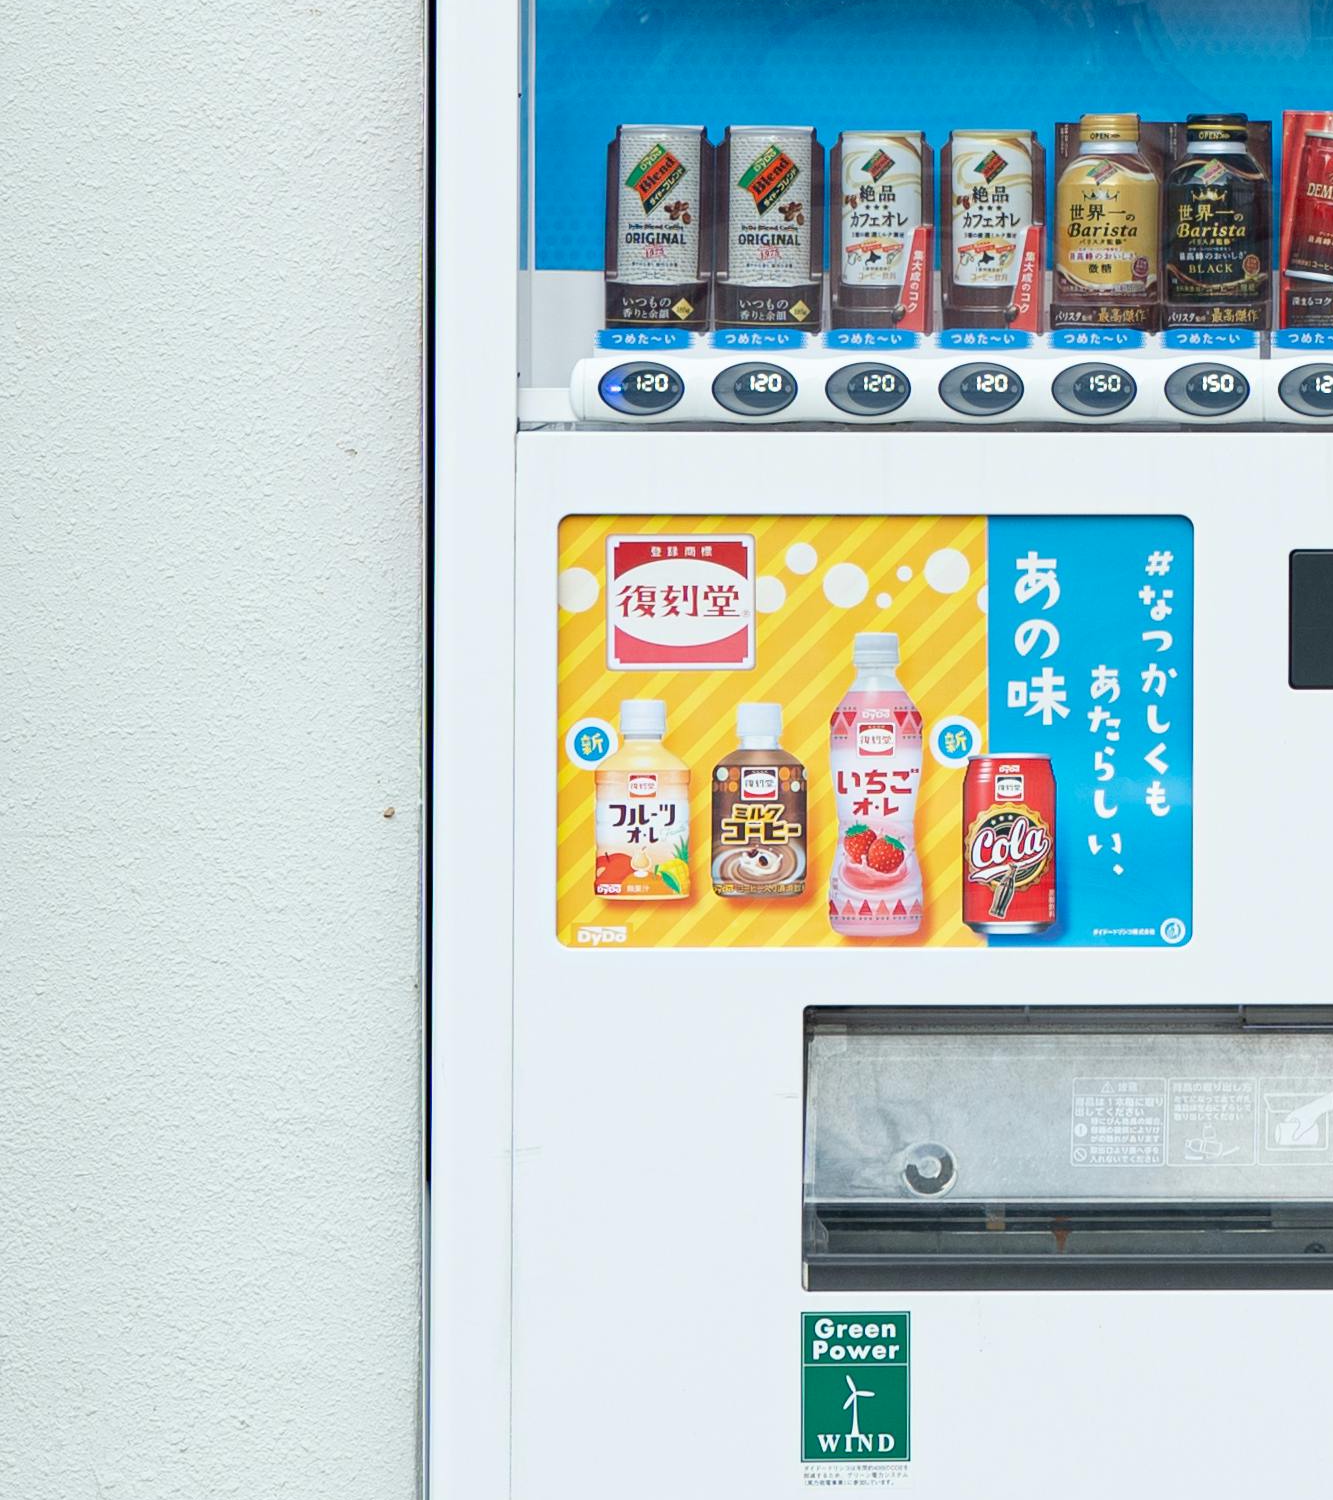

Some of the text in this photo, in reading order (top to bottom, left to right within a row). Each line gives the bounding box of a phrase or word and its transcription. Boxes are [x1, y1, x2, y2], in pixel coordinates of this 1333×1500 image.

[850, 212, 909, 227] カフェオレ
[962, 212, 1021, 228] カフェオレ
[1070, 204, 1135, 222] 世界一の
[1178, 204, 1243, 222] 世界一の
[625, 233, 687, 245] ORIGINAL
[1067, 222, 1138, 238] Barista
[1177, 222, 1246, 238] Barista
[738, 233, 801, 246] ORIGINAL
[1188, 263, 1233, 273] BLACK
[622, 297, 672, 309] いつもの
[1291, 297, 1333, 308] 深まるコク
[750, 374, 782, 392] 120
[1090, 374, 1120, 392] 150
[650, 546, 712, 558] 登録商標
[616, 584, 740, 618] 復刻堂
[1007, 551, 1071, 726] あの味
[1138, 551, 1178, 818] #なつかしくも
[581, 733, 604, 756] 新
[944, 731, 967, 754] 新
[838, 768, 920, 795] いちご
[608, 804, 676, 828] フルーツ
[732, 804, 784, 822] ミルク
[721, 820, 802, 845] コーヒー
[972, 817, 1045, 868] Cola
[576, 926, 628, 946] DyDo
[814, 1318, 896, 1339] Green
[812, 1340, 900, 1360] Power
[817, 1434, 895, 1453] WIND
